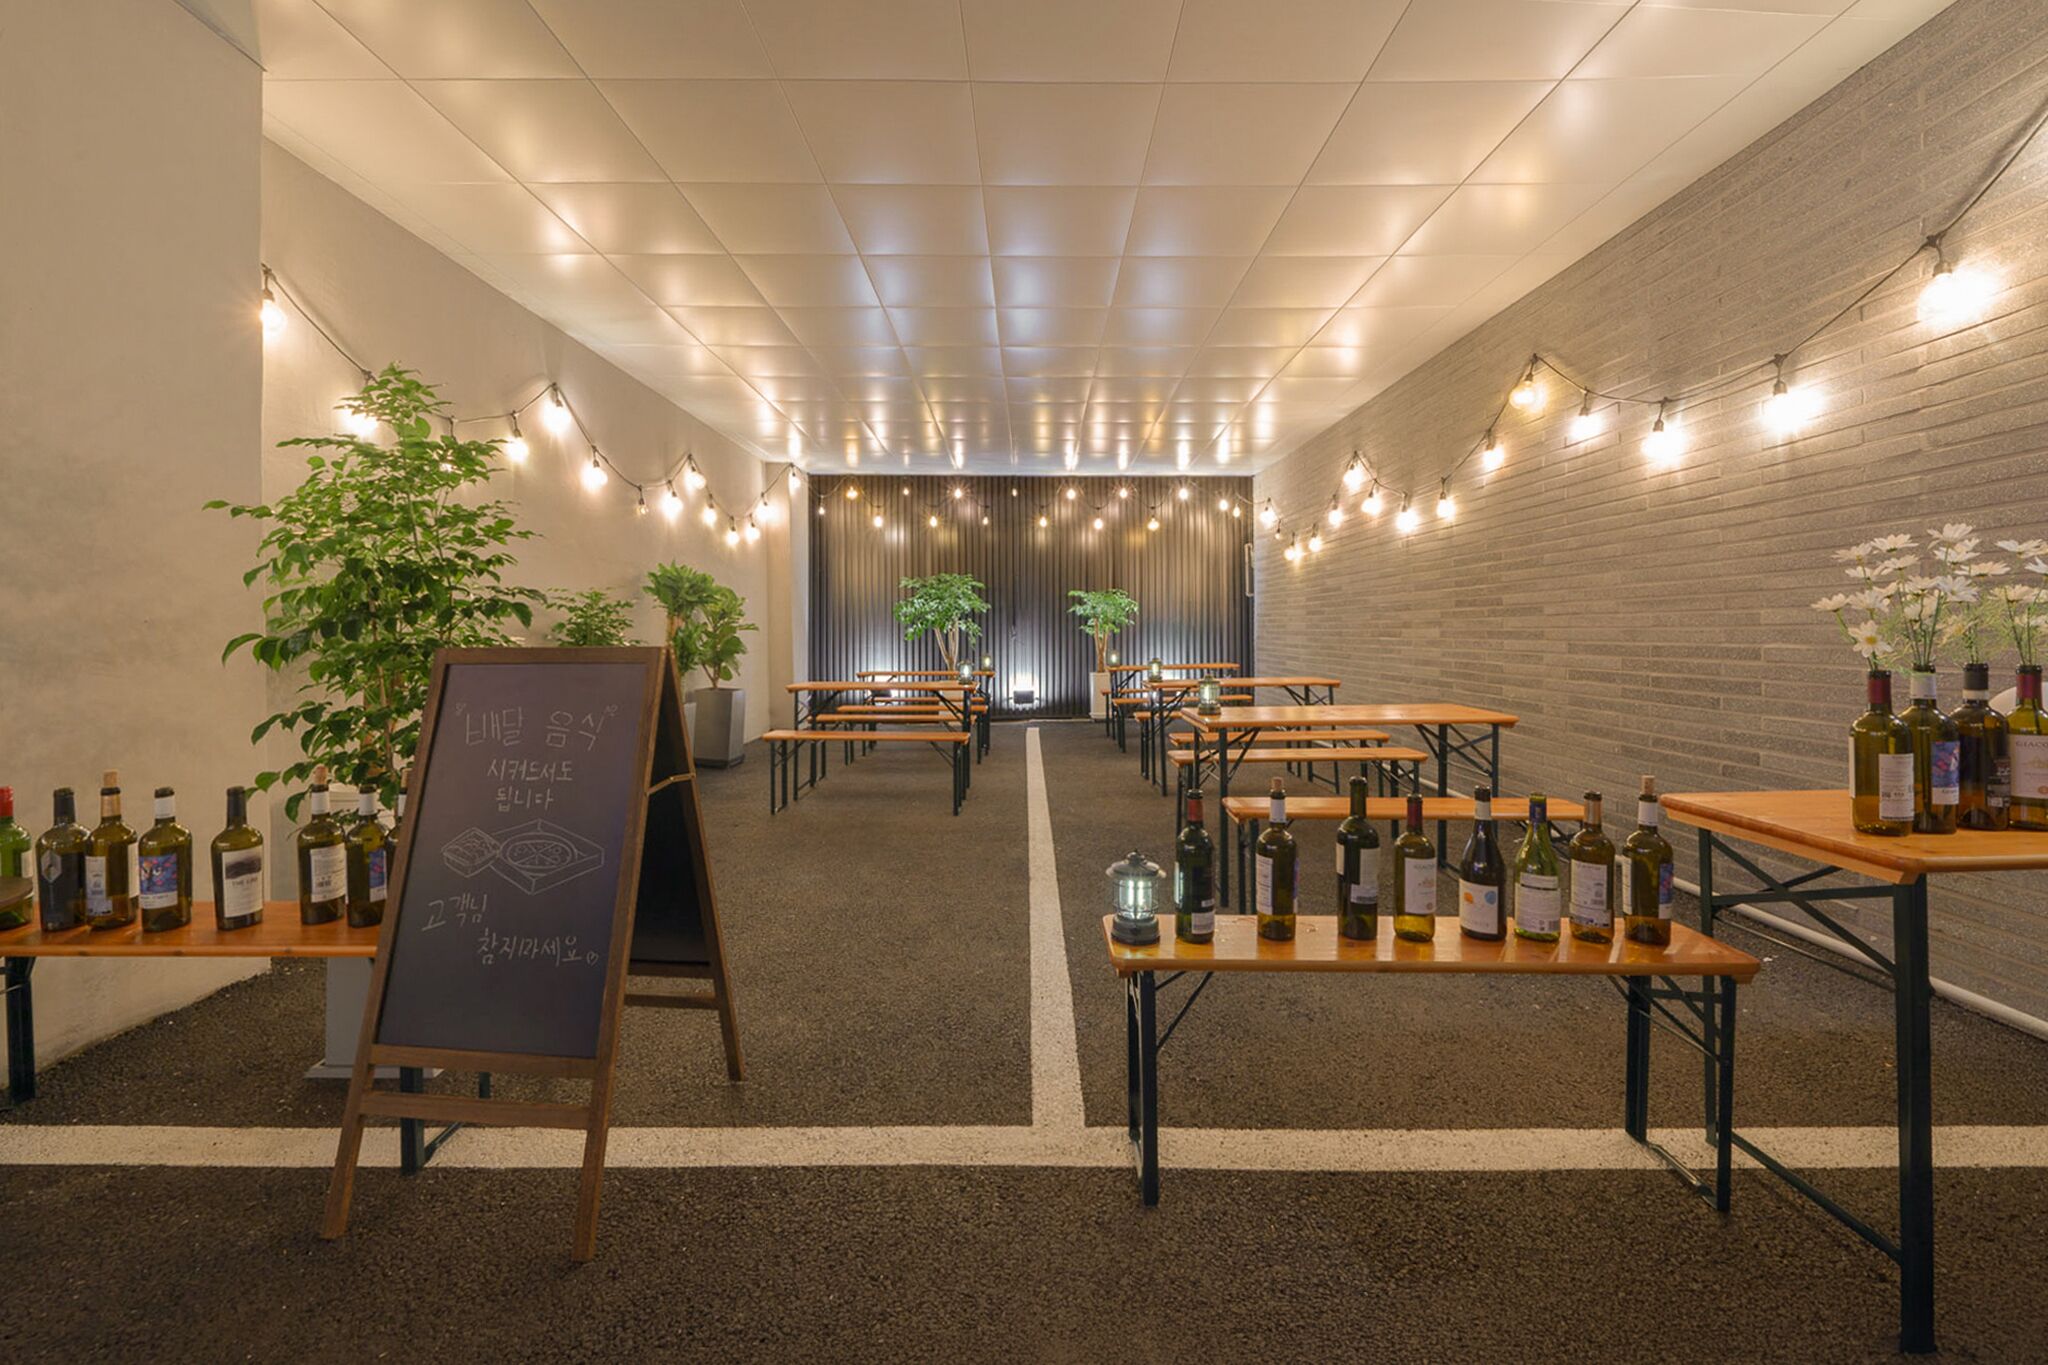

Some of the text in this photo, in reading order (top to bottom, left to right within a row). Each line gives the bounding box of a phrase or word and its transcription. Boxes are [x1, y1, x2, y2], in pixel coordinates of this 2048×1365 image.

[466, 707, 605, 752] 배달 음식
[496, 785, 555, 812] 됩니다
[421, 892, 488, 932] 고객님
[477, 927, 583, 967] 참지마세요
